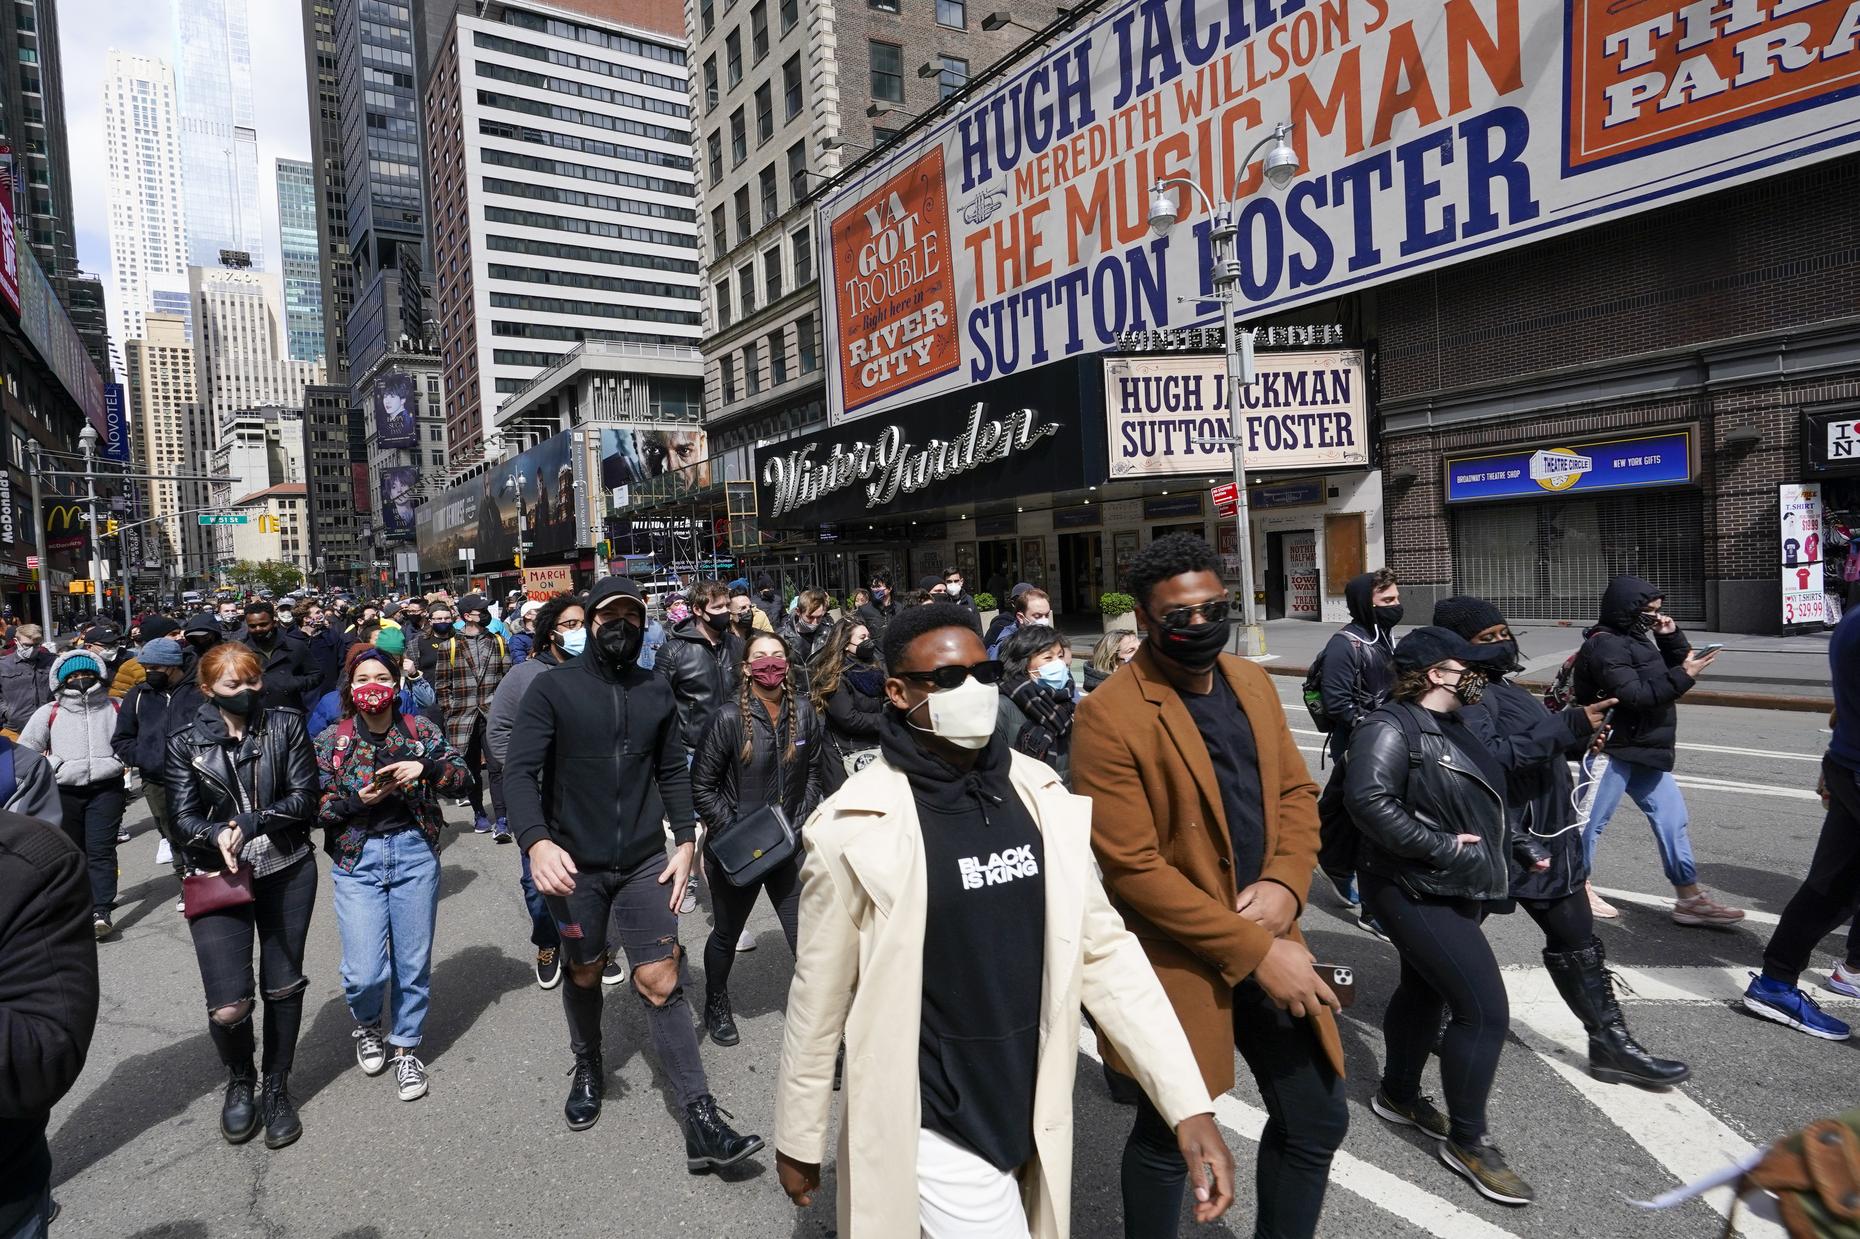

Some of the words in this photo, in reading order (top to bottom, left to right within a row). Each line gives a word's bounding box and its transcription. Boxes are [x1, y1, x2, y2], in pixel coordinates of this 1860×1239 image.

[958, 38, 1096, 194] HUGH
[1112, 0, 1310, 110] JAC
[1014, 91, 1164, 207] MEREDITH
[1174, 0, 1389, 125] WILLSONS
[964, 197, 1053, 303] THE
[1065, 96, 1264, 267] MUSIC
[1288, 0, 1524, 177] MAN
[864, 191, 908, 238] YA
[858, 212, 920, 277] GOT
[845, 231, 940, 319] TROUBLE
[863, 305, 887, 333] Right
[888, 295, 912, 317] here
[913, 288, 924, 307] in
[968, 236, 1170, 384] SUTTON
[849, 300, 948, 367] RIVER
[1115, 328, 1223, 351] WINTER
[1235, 324, 1344, 347] ARDEN
[861, 335, 934, 388] CITY
[1119, 375, 1203, 414] HUGH
[104, 389, 121, 453] NOVOTEL
[1121, 417, 1233, 457] SUTTON
[1247, 412, 1354, 451] FOSTER
[1836, 424, 1851, 440] I
[763, 442, 875, 518] Winter
[865, 402, 1059, 508] Garden
[1544, 456, 1568, 473] THEATRE
[1569, 458, 1591, 471] CIRCLE
[1613, 458, 1627, 469] NEW
[1628, 457, 1643, 467] YORK
[1643, 455, 1661, 465] GIFTS
[1832, 439, 1860, 456] N
[1486, 471, 1506, 482] THEATRE
[1507, 470, 1520, 480] SHOP
[0, 470, 14, 544] McDonald's
[530, 570, 566, 581] MARCH
[1295, 596, 1316, 604] TREAT
[1785, 603, 1794, 620] 3
[1799, 602, 1822, 618] $29.99
[961, 871, 984, 890] IS
[985, 859, 1039, 886] KING
